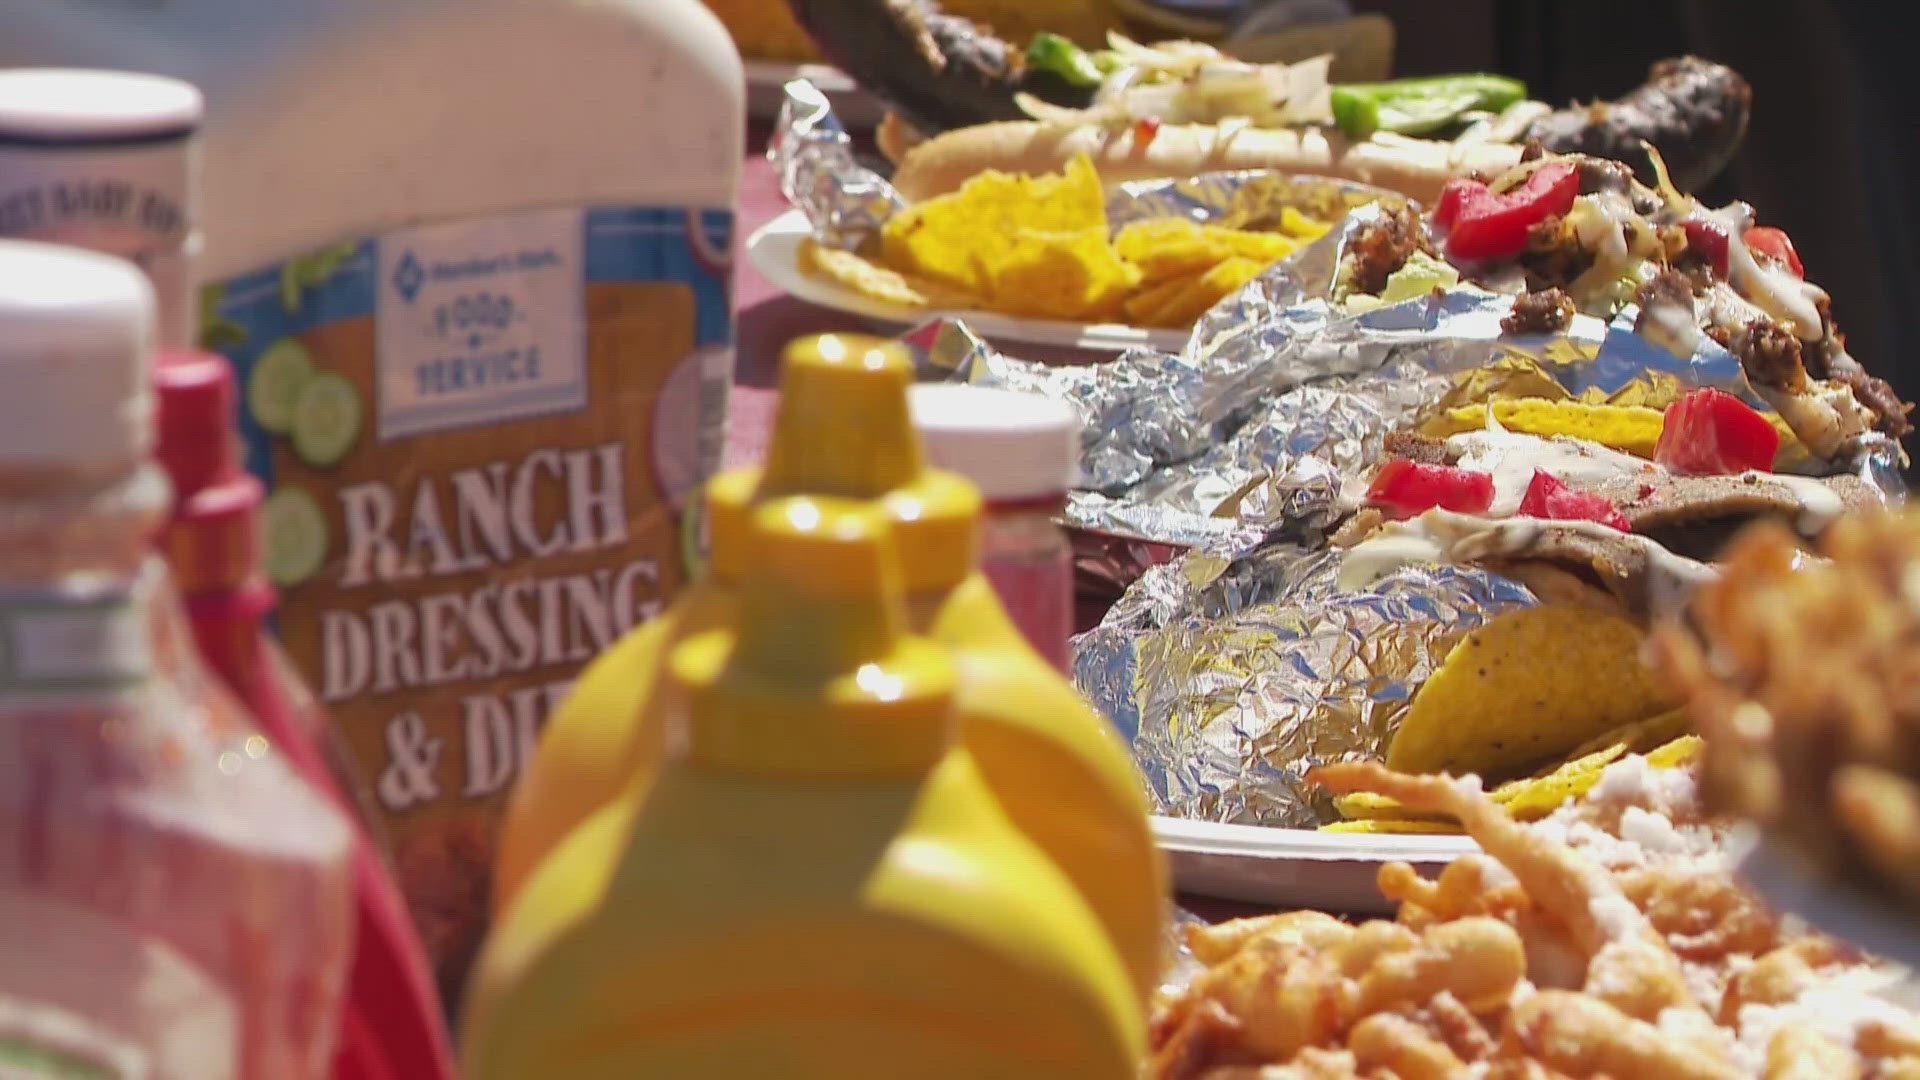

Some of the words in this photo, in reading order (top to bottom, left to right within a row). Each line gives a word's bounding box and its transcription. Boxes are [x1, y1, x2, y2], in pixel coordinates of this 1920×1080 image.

[415, 346, 542, 396] SERVICE
[433, 292, 514, 338] FOOD
[338, 443, 629, 588] RANCH
[321, 560, 663, 701] DRESSING
[378, 711, 442, 810] &
[462, 679, 578, 797] DI
